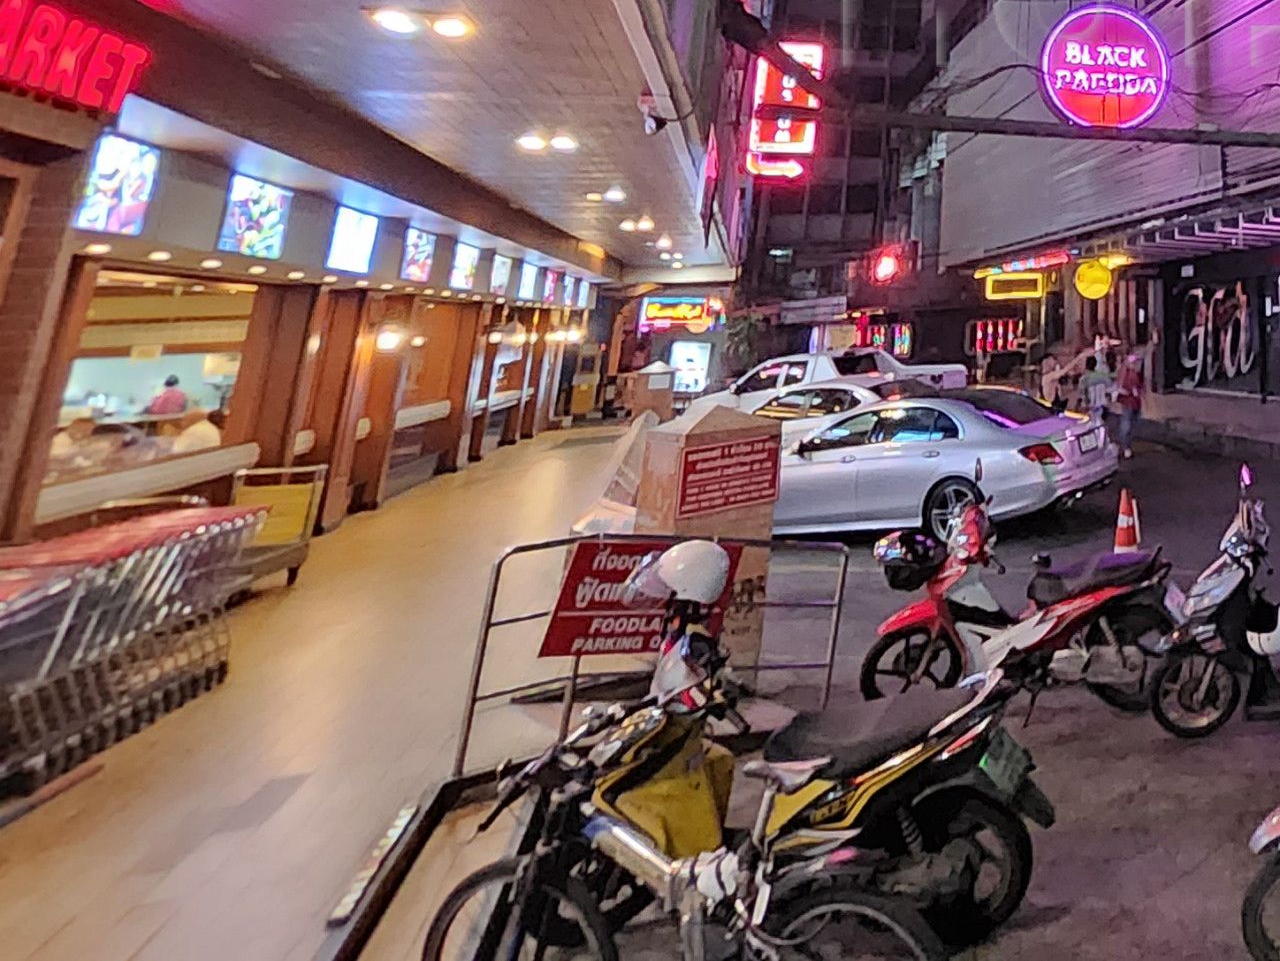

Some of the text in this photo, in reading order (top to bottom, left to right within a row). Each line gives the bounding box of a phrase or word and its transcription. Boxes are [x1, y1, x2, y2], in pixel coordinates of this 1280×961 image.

[1064, 40, 1149, 68] BLACK
[589, 617, 663, 634] FOODLA
[571, 637, 643, 654] PARKING
